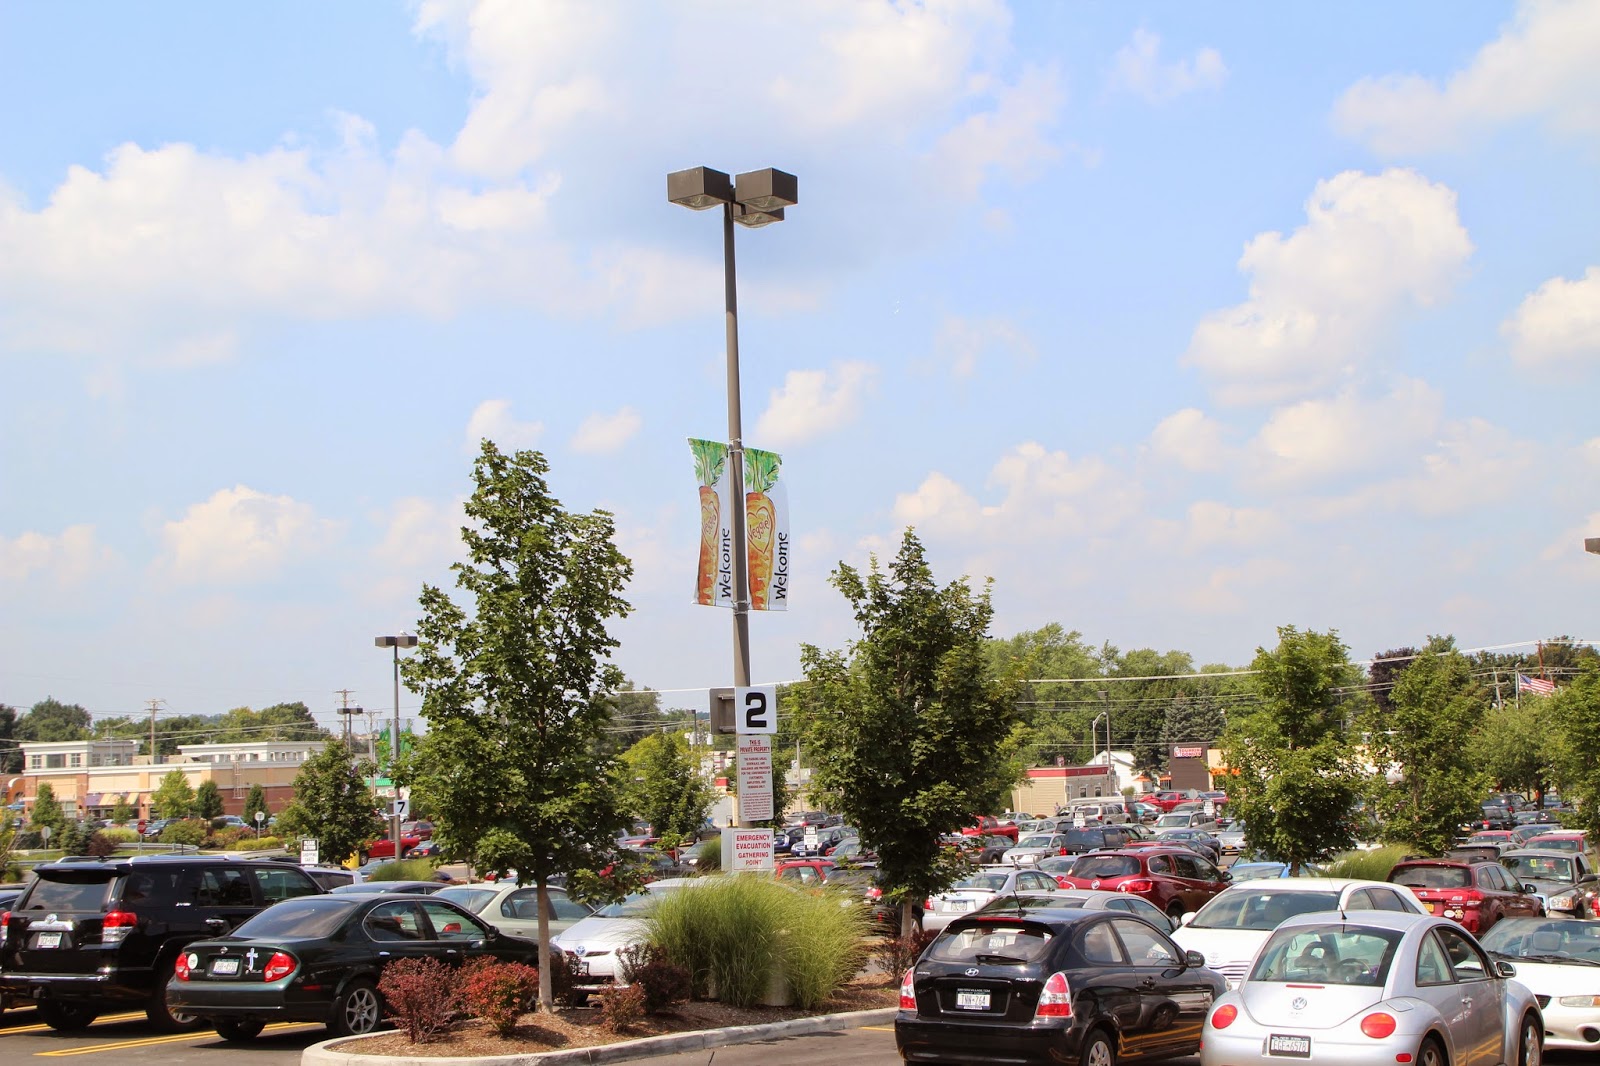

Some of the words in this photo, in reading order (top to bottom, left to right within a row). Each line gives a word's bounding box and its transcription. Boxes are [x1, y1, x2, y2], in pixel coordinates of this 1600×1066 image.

[719, 528, 731, 598] Welcome
[773, 532, 788, 600] Welcome
[745, 692, 767, 728] 2
[397, 801, 405, 813] 7
[736, 842, 771, 850] EVACUATION
